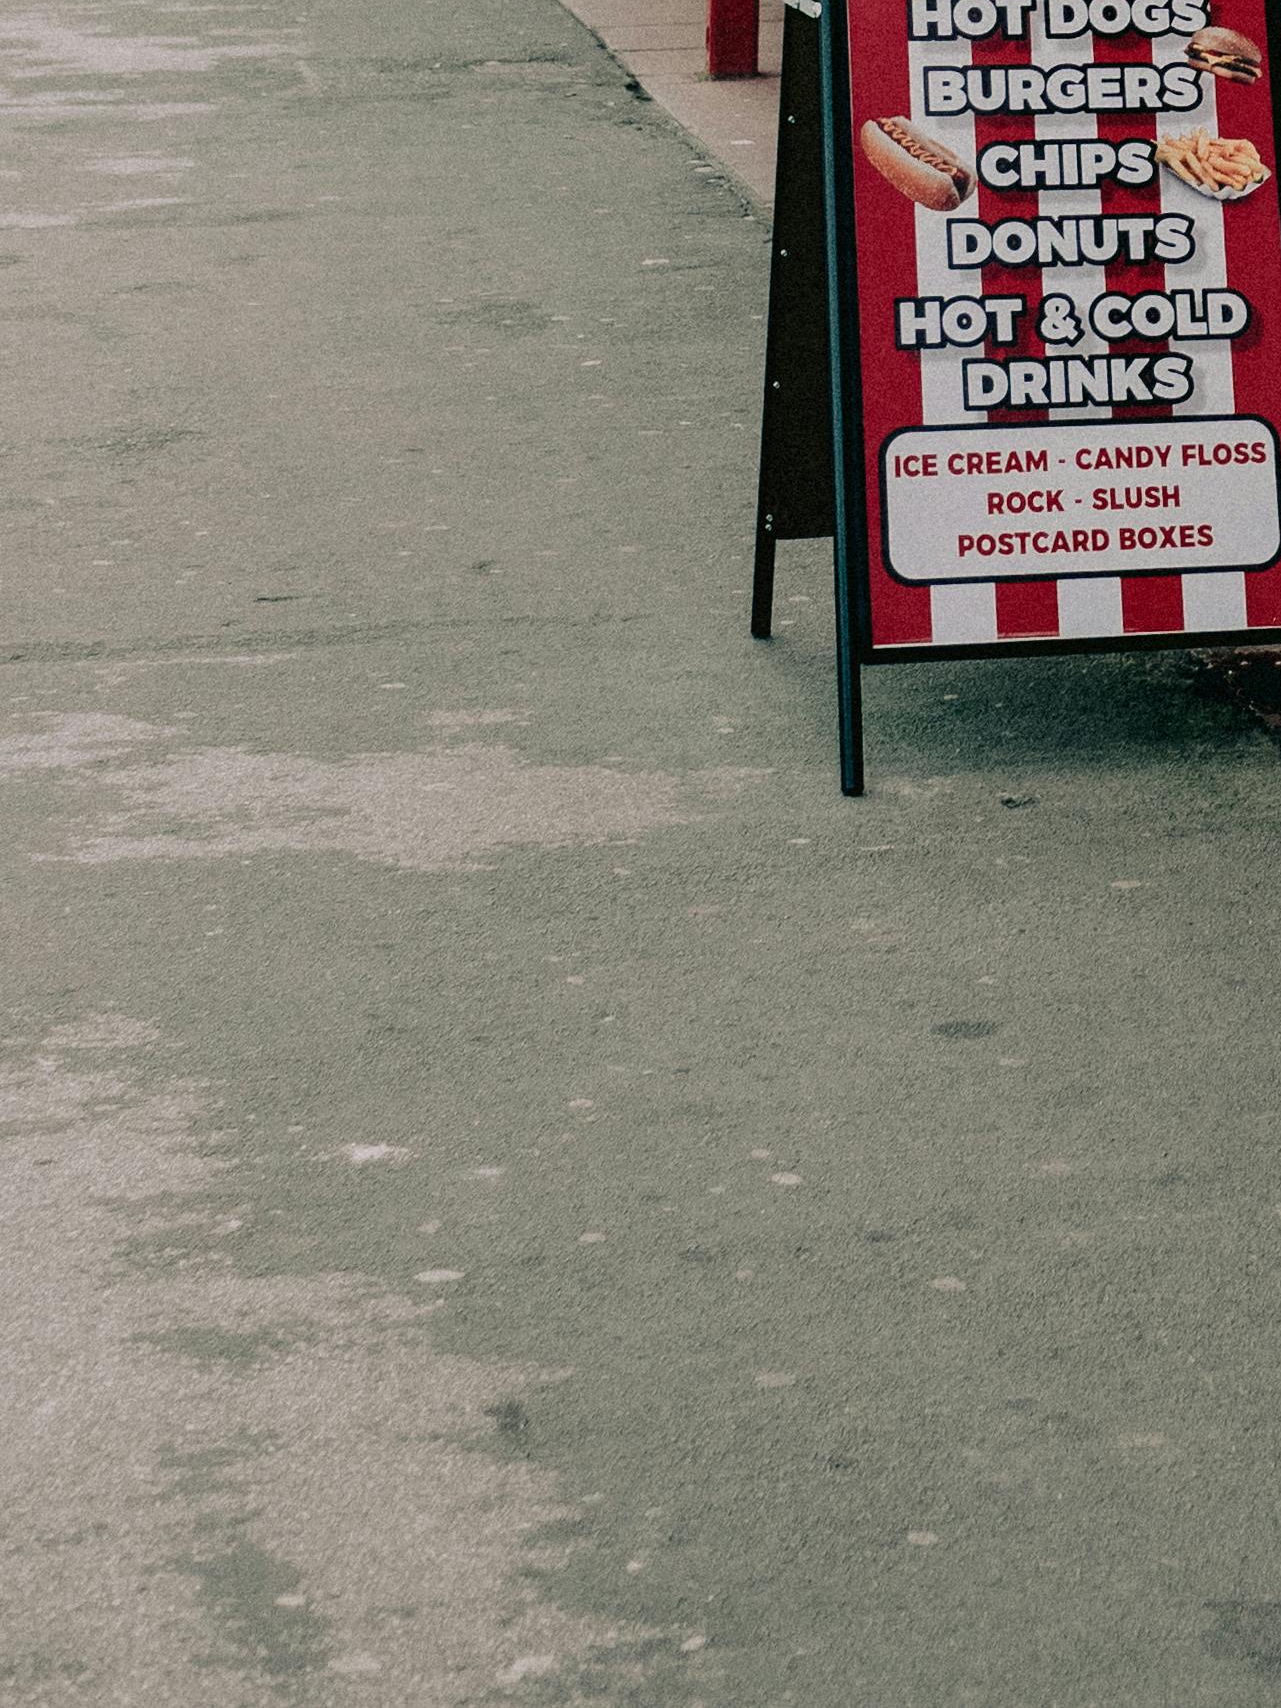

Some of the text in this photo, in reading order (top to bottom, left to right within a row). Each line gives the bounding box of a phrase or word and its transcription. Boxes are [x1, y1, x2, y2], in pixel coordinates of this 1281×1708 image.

[924, 62, 1202, 117] BURGERS
[976, 138, 1157, 191] CHIPS
[947, 216, 1196, 271] DONUTS
[896, 288, 1252, 349] HOT & COLD
[963, 354, 1195, 411] DRINKS
[895, 440, 1267, 478] ICE CREAM CANDY FLOSS
[987, 486, 1182, 515] ROCK SLUSH
[958, 524, 1214, 558] POSTCARD BOXES
